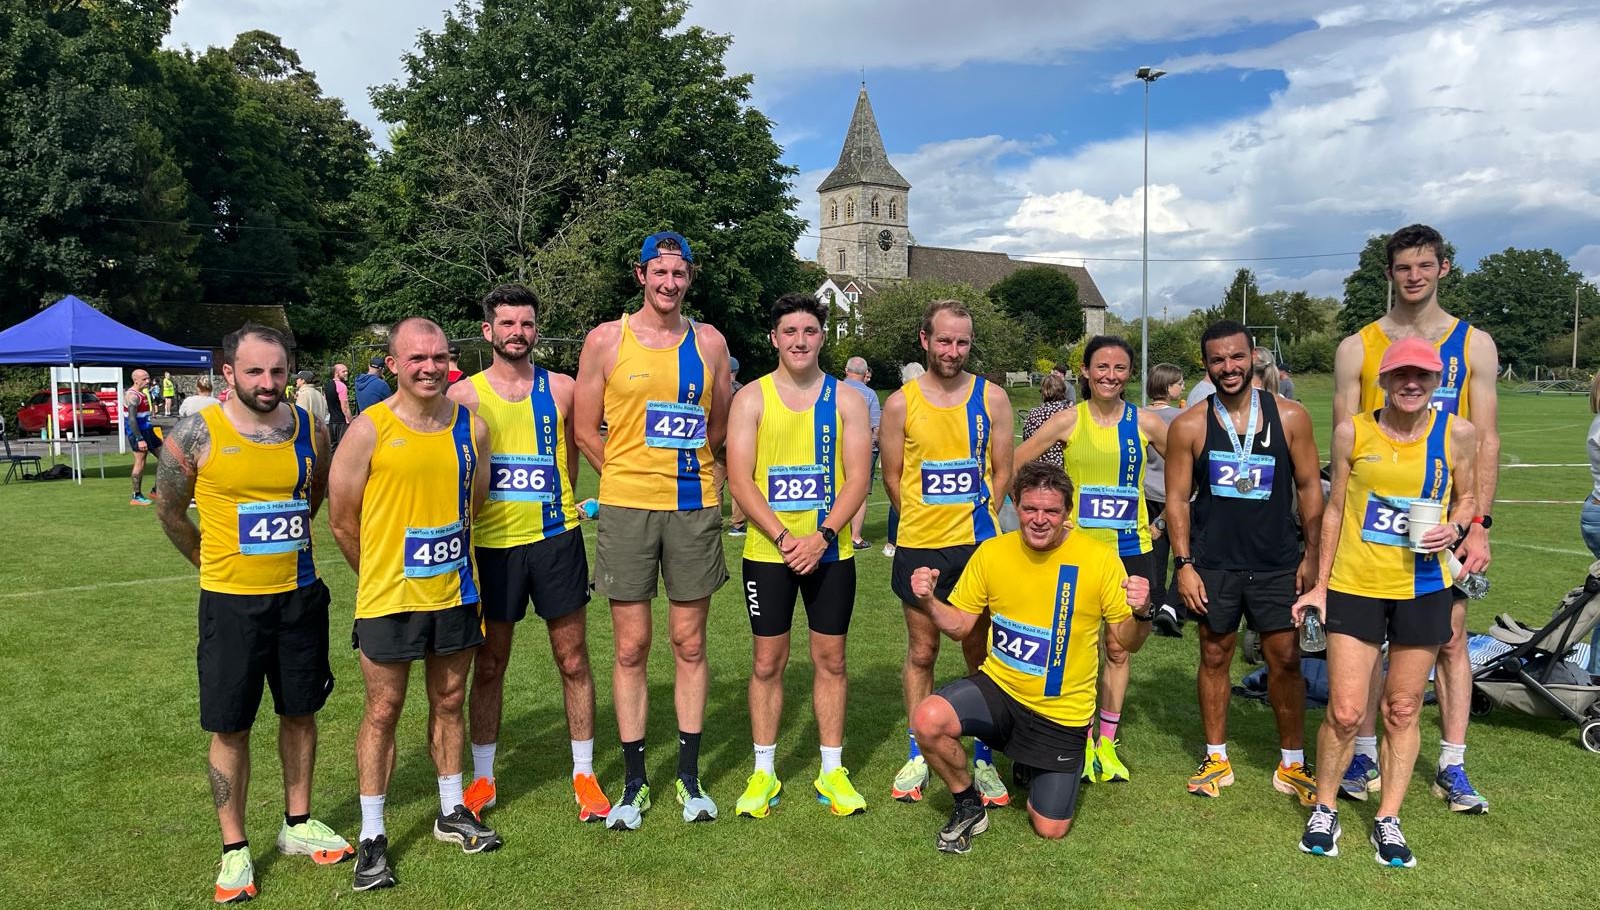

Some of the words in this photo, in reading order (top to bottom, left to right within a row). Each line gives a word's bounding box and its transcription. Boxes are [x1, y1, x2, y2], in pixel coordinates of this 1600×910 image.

[654, 415, 699, 438] 427
[496, 468, 546, 490] 286
[774, 478, 818, 500] 282
[927, 472, 973, 494] 259
[240, 503, 266, 511] Overton
[1090, 498, 1129, 519] 157
[248, 515, 304, 541] 428
[435, 527, 446, 535] Mile
[1373, 507, 1410, 534] 36
[412, 537, 462, 565] 489
[1023, 625, 1036, 634] Road
[1053, 582, 1071, 667] BOURNEMOUTH
[997, 630, 1040, 661] 247
